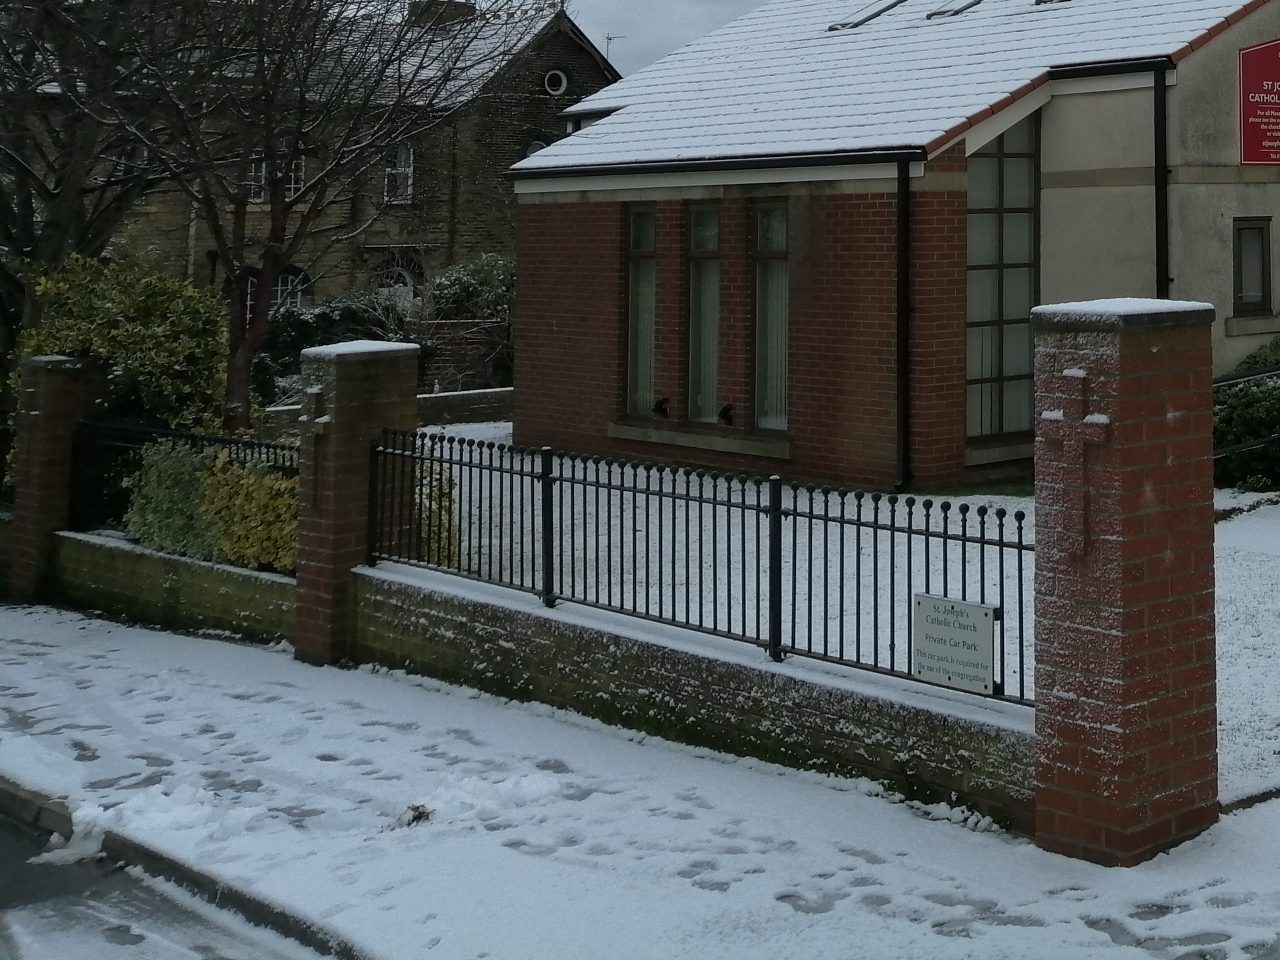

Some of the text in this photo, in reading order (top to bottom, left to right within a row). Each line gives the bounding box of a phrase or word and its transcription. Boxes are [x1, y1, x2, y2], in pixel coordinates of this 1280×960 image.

[1263, 82, 1272, 90] ST
[932, 604, 969, 618] St. Joseph's
[925, 615, 977, 632] Catholic Church
[925, 633, 978, 652] Private Car Park
[916, 649, 926, 657] This
[956, 659, 980, 670] required
